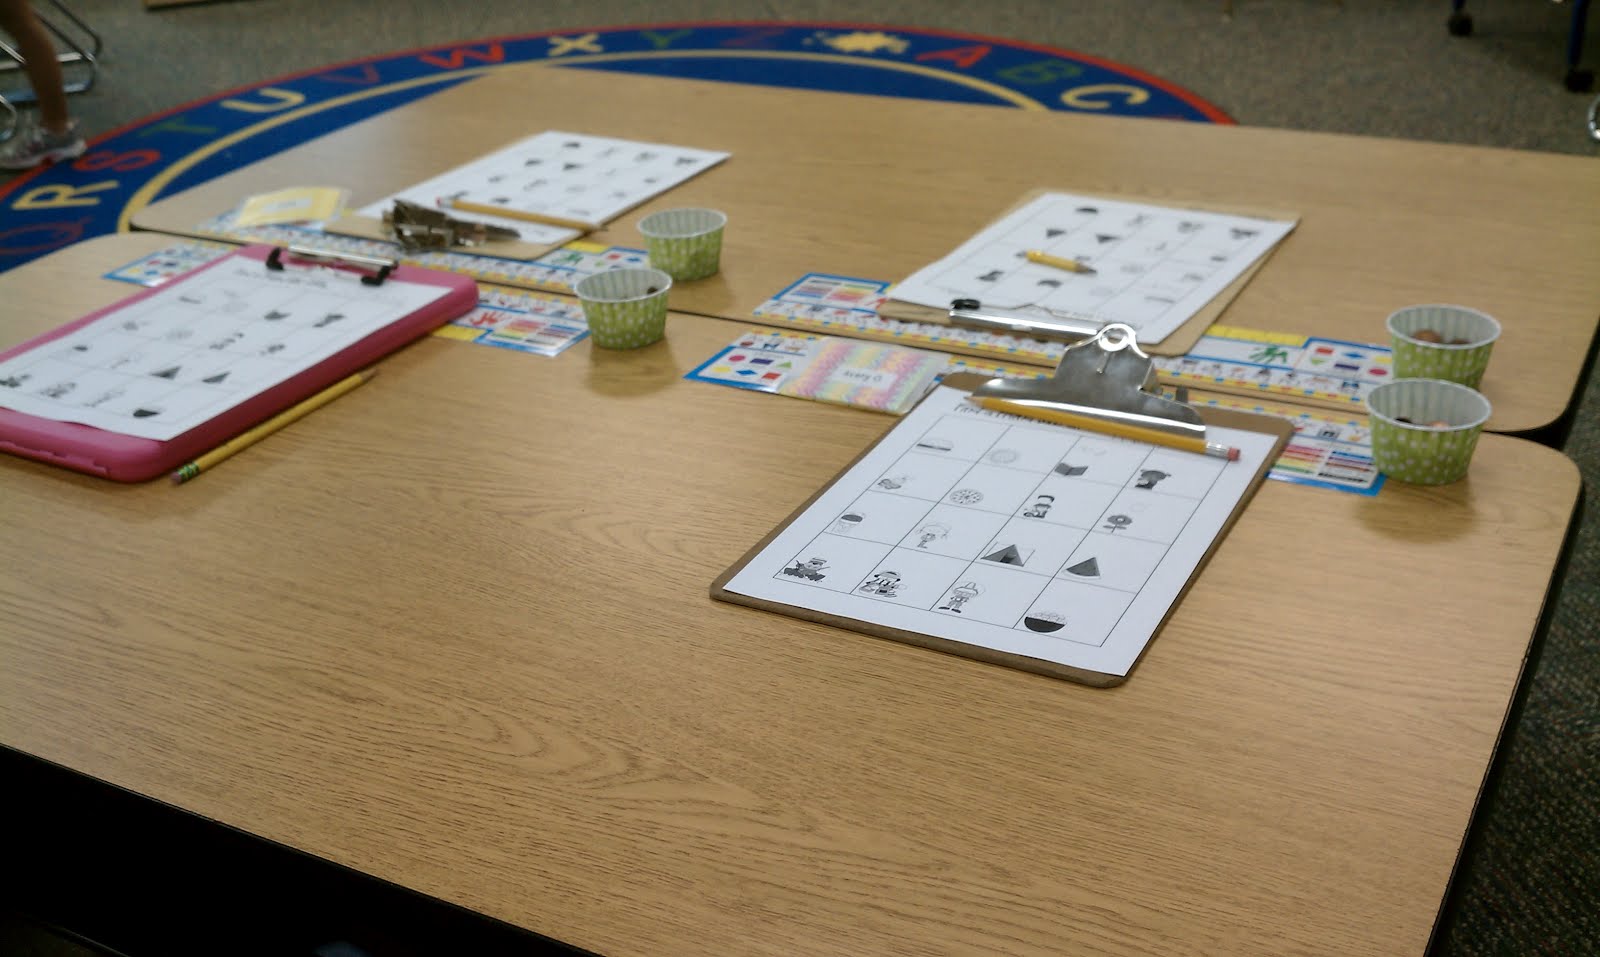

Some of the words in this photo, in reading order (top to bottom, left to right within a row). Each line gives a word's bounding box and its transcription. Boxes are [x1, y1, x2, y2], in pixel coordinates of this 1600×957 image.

[11, 180, 119, 210] R
[72, 149, 161, 172] S
[138, 118, 217, 137] T
[220, 88, 305, 113] U
[317, 63, 380, 85] V
[420, 44, 505, 69] W
[548, 33, 602, 56] X
[640, 29, 693, 48] Y
[721, 27, 786, 48] Z
[915, 45, 992, 68] A
[997, 59, 1083, 85] B
[1060, 83, 1150, 109] C
